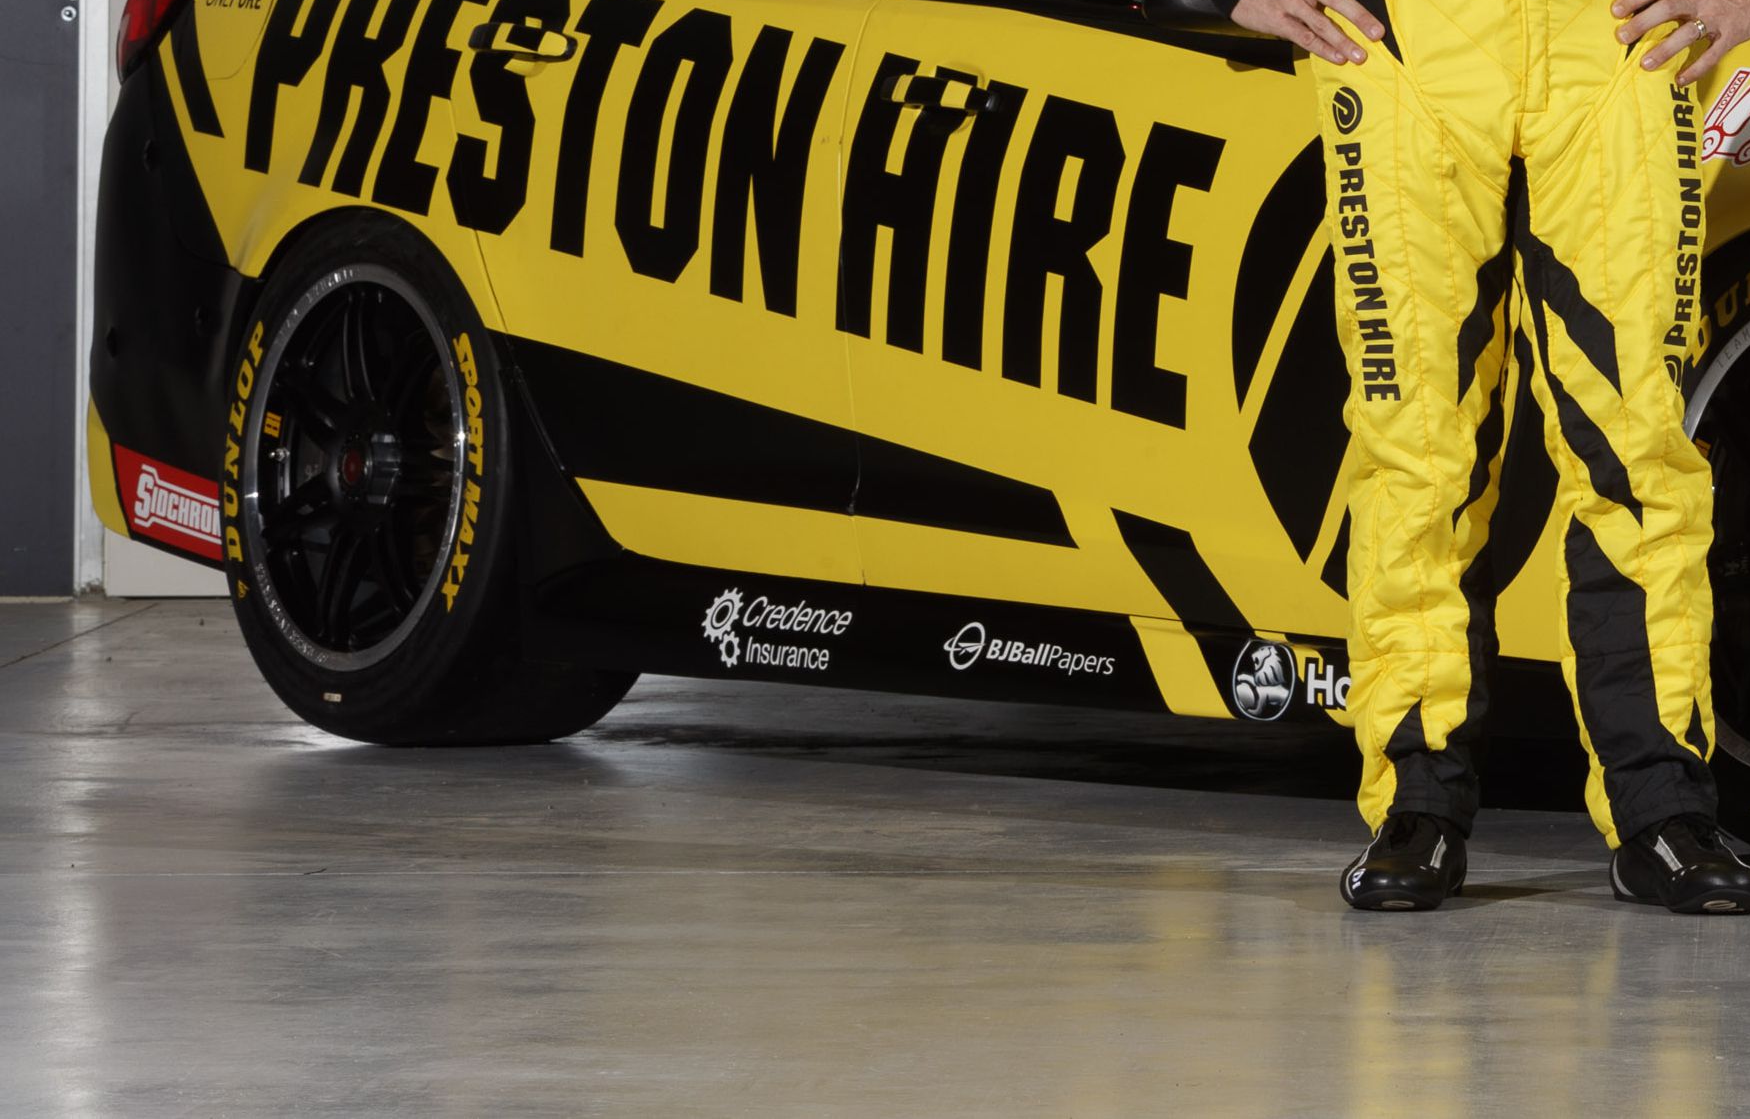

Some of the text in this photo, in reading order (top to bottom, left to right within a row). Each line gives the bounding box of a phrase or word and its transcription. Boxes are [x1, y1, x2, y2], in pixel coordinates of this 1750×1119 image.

[1663, 83, 1702, 347] PRESTON HIRE
[1716, 72, 1747, 113] TOYOTA
[834, 53, 1226, 430] HIRE
[1334, 142, 1402, 403] PRESTON HIRE
[223, 319, 265, 563] DUNLOP
[441, 332, 484, 614] SPORT MAXX
[742, 596, 853, 637] Credence
[745, 638, 830, 672] Insurance
